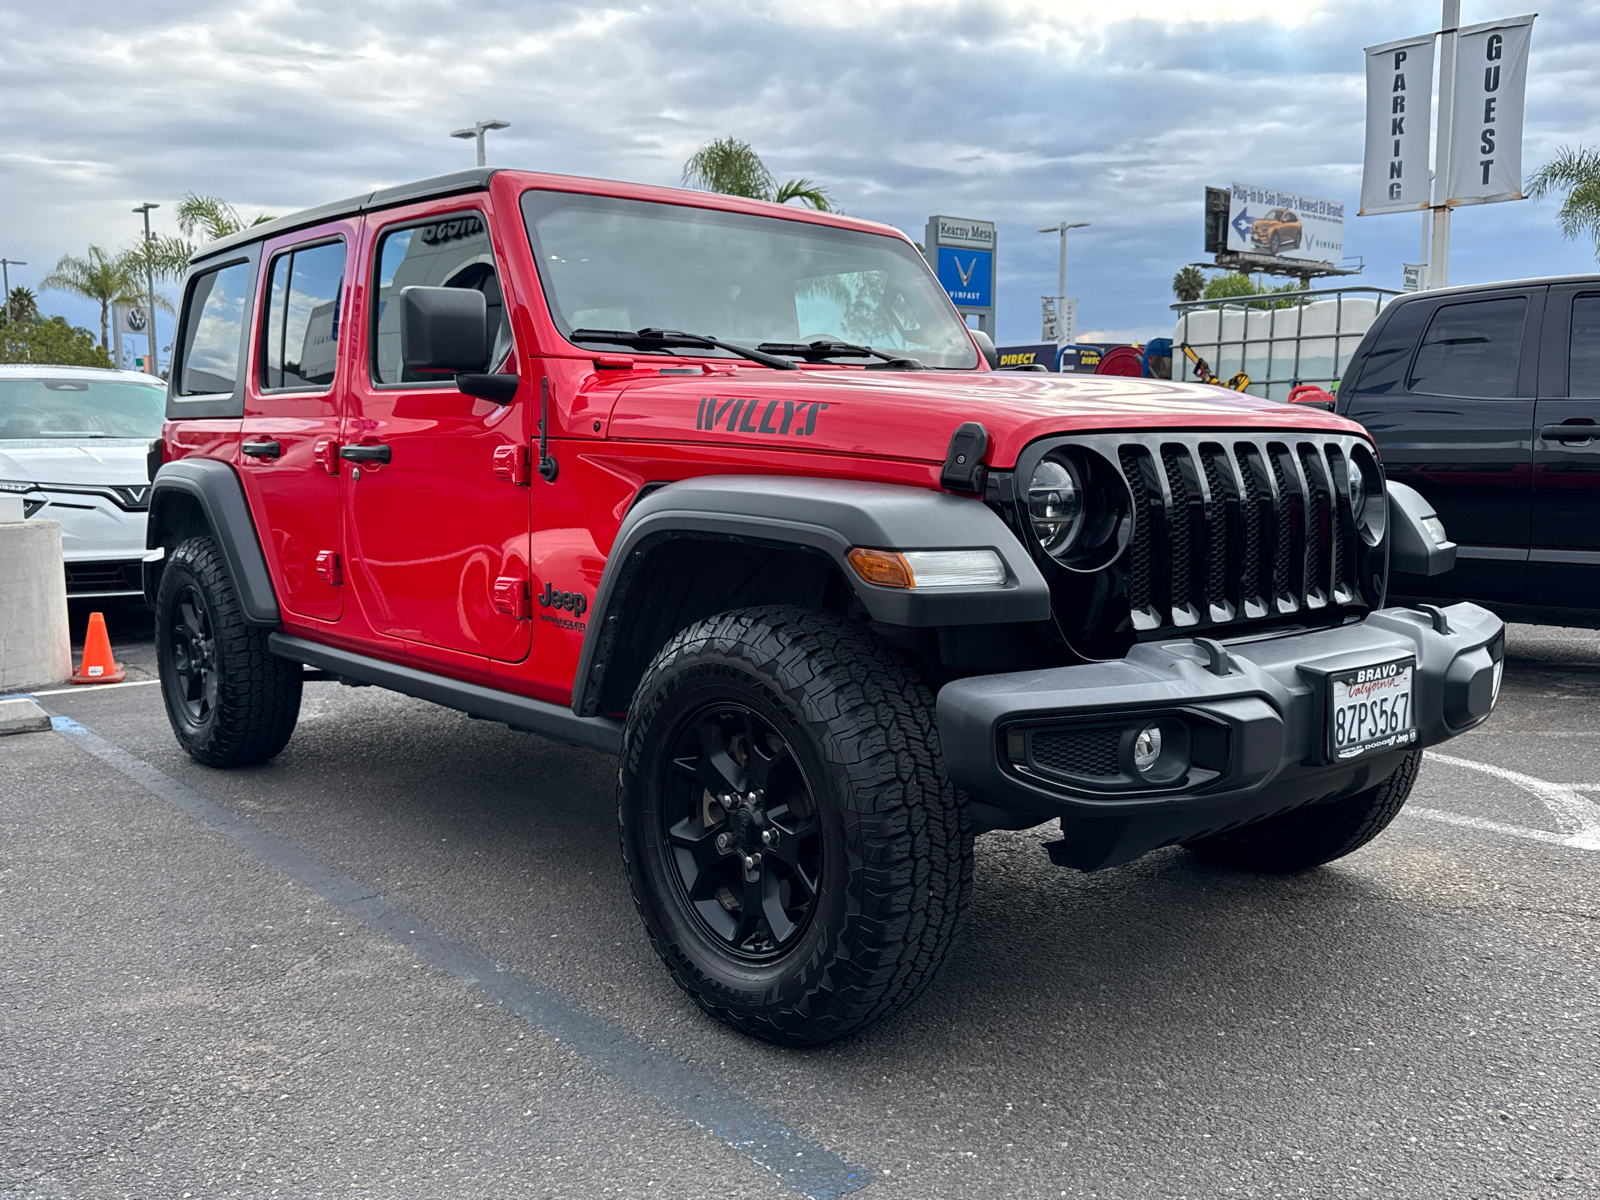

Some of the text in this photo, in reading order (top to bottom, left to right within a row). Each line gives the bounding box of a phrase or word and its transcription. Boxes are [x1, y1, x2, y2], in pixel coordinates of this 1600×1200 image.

[1479, 34, 1503, 186] GUEST
[1388, 51, 1407, 201] PARKING
[1232, 185, 1345, 218] Plug-in to San Diego's Newest EV Brand!
[940, 222, 992, 241] Kearny Mesa
[1315, 239, 1343, 251] VINFAST
[949, 290, 980, 300] VINFAST
[1000, 352, 1037, 366] DIRECT
[1080, 356, 1101, 365] DIREC
[696, 397, 831, 436] WILLYS
[538, 581, 588, 618] Jeep
[539, 613, 587, 630] WRANGLER
[1357, 664, 1397, 683] BRAVO
[1348, 677, 1401, 700] California
[628, 680, 669, 777] ROCKY
[674, 662, 802, 728] MOUNTAIN
[1335, 691, 1410, 746] 8ZPS567
[1396, 733, 1409, 744] Jeep
